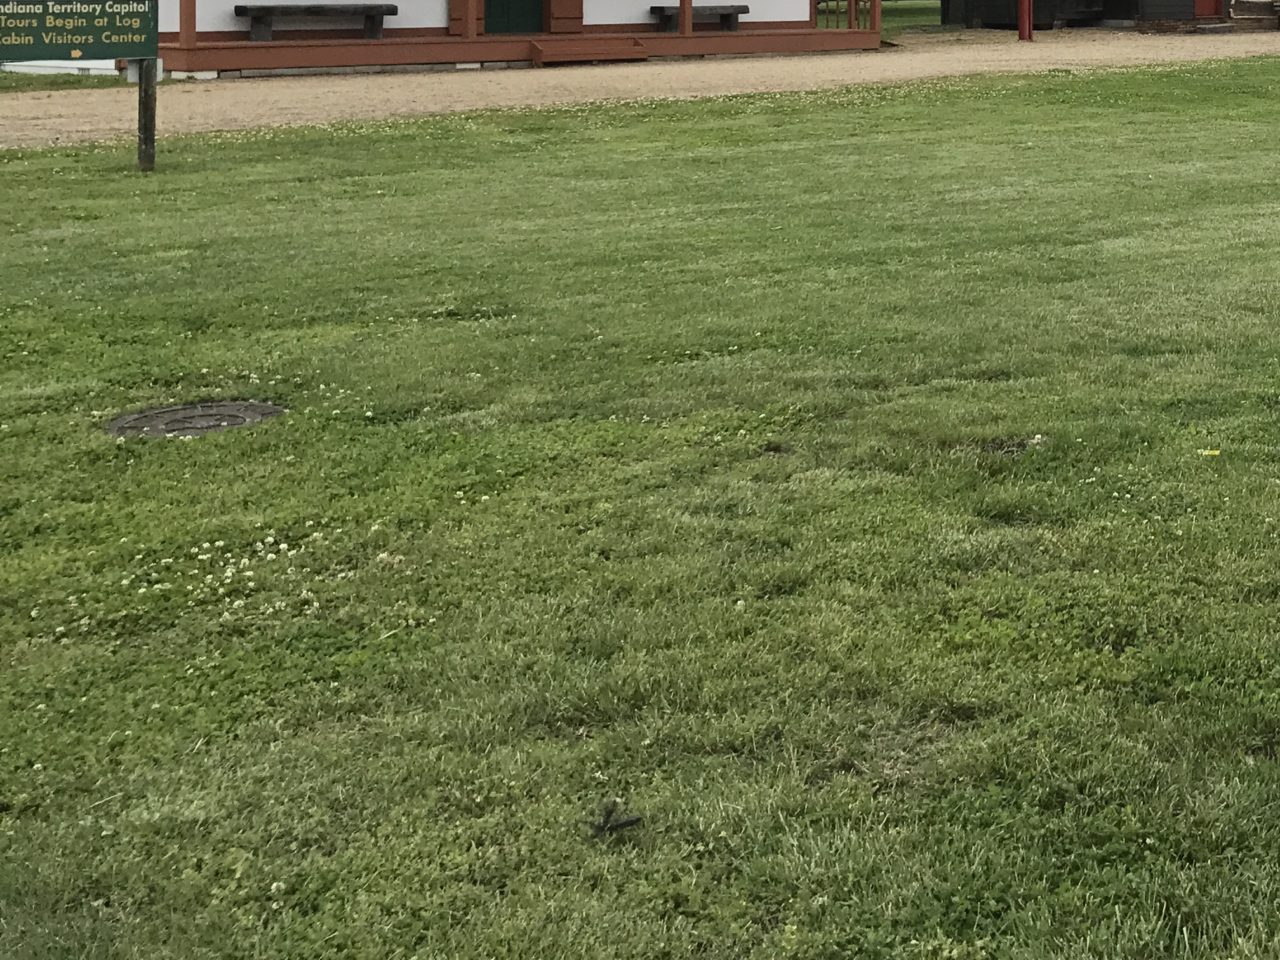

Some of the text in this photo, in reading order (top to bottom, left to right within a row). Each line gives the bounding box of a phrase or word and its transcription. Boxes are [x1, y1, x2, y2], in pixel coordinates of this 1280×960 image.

[0, 0, 149, 16] ndiana Territory Capitol
[0, 14, 140, 30] Tours Begin at Log
[0, 31, 147, 45] abin Visitors Center
